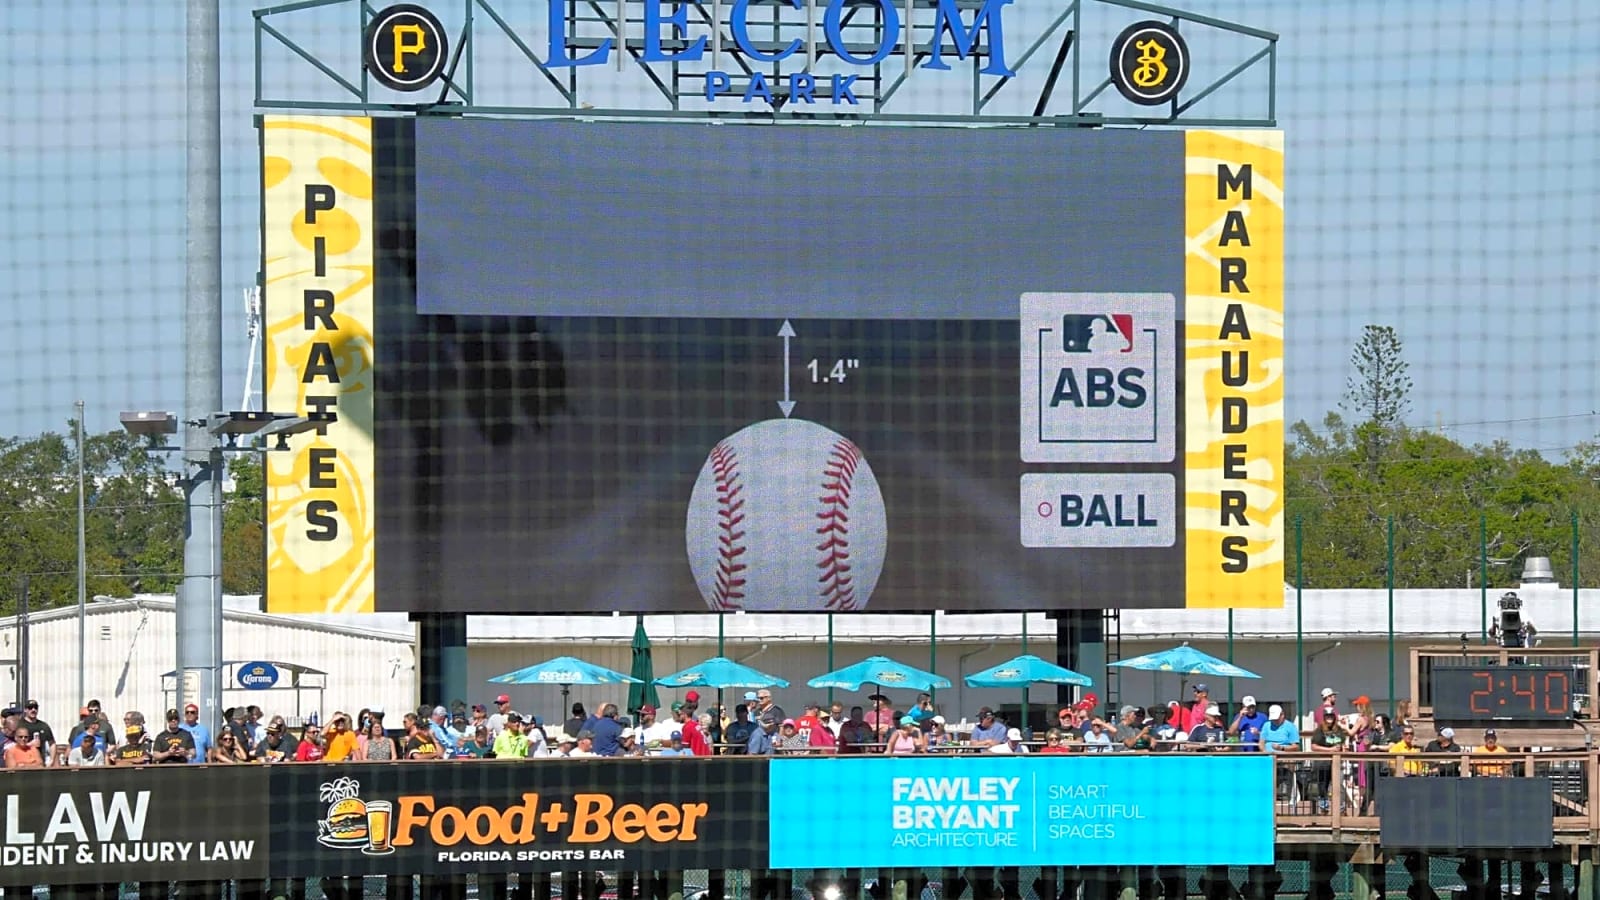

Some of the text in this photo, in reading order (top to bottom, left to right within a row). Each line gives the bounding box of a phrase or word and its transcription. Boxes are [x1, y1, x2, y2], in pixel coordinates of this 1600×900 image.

[541, 0, 1017, 77] LECOM
[704, 71, 860, 105] PARK
[302, 184, 341, 542] PIRATES
[807, 359, 860, 384] 1.4"
[1217, 164, 1253, 574] MARAUDERS
[1050, 367, 1147, 409] ABS
[1060, 494, 1158, 527] BALL
[243, 674, 272, 685] Corona
[1469, 672, 1568, 714] 2:40
[892, 777, 1020, 801] FAWLEY
[1049, 785, 1109, 799] SMART
[6, 790, 151, 844] LAW
[391, 792, 709, 846] Food+Beer
[892, 805, 1020, 829] BRYANT
[1049, 804, 1145, 819] BEAUTIFUL
[892, 832, 1018, 847] ARCHITECTURE
[1049, 824, 1115, 839] SPACES
[0, 840, 255, 866] DENT & INJURY LAW
[438, 849, 625, 862] FLORIDA SPORTS BAR
